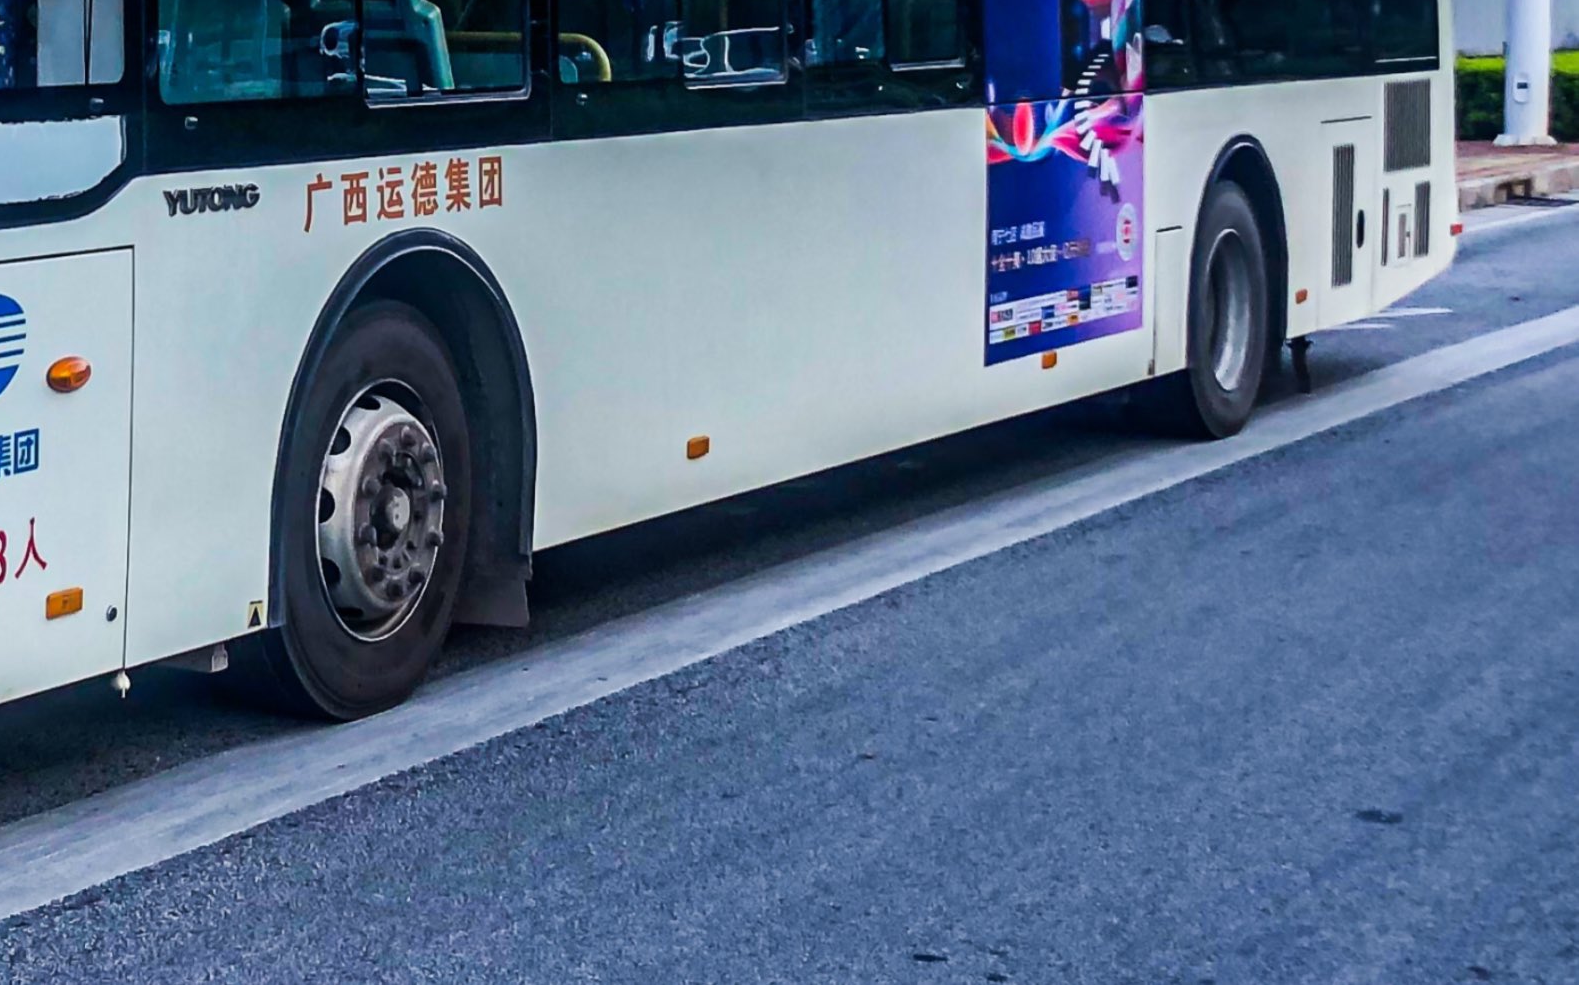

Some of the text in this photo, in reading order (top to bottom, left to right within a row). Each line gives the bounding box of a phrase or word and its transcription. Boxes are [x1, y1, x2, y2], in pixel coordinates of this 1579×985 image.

[162, 183, 260, 217] YUTONG
[303, 156, 503, 233] 广西运德集团
